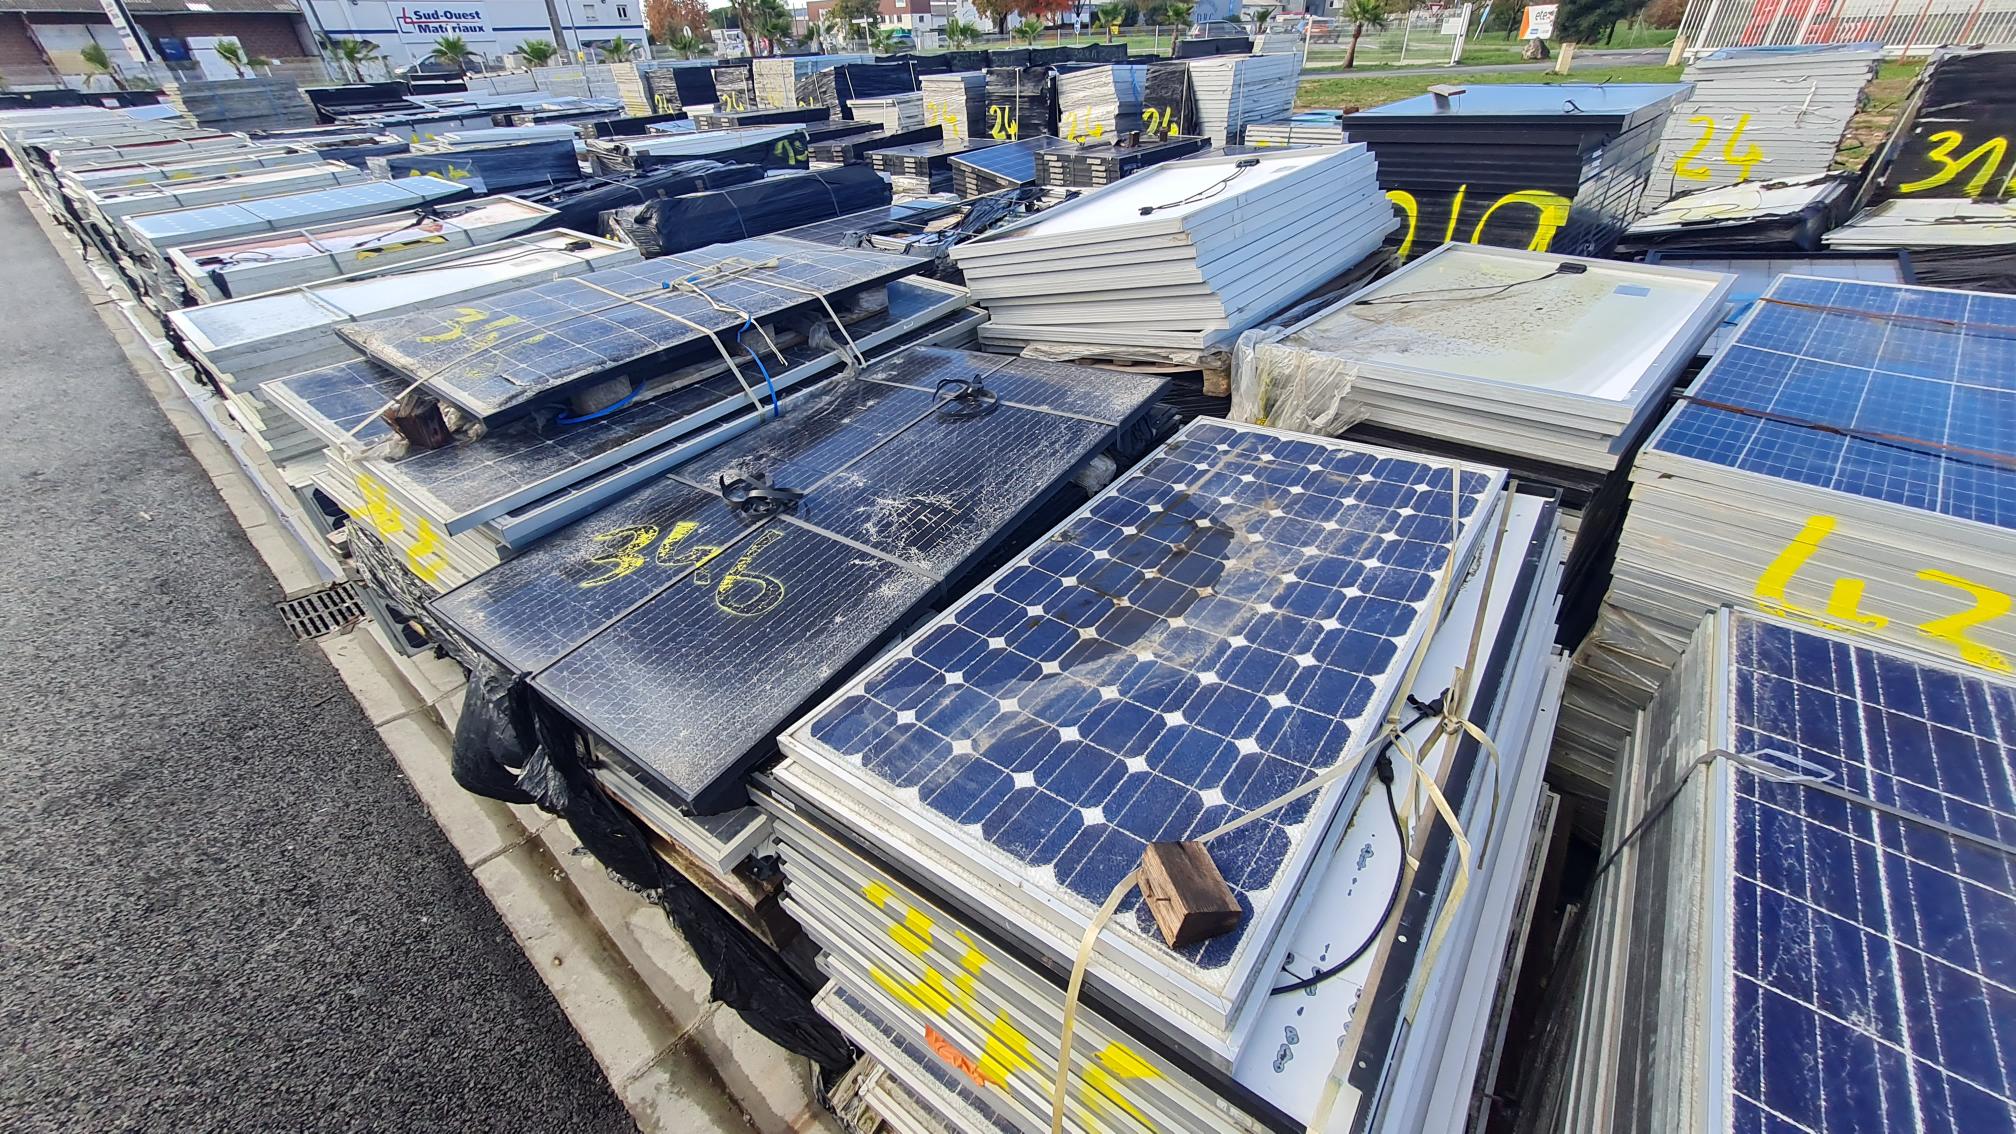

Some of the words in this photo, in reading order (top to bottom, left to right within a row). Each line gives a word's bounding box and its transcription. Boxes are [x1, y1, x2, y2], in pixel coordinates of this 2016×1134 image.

[413, 9, 481, 20] Sud-Ouest
[989, 104, 1018, 141] 24
[1675, 112, 1764, 183] 24
